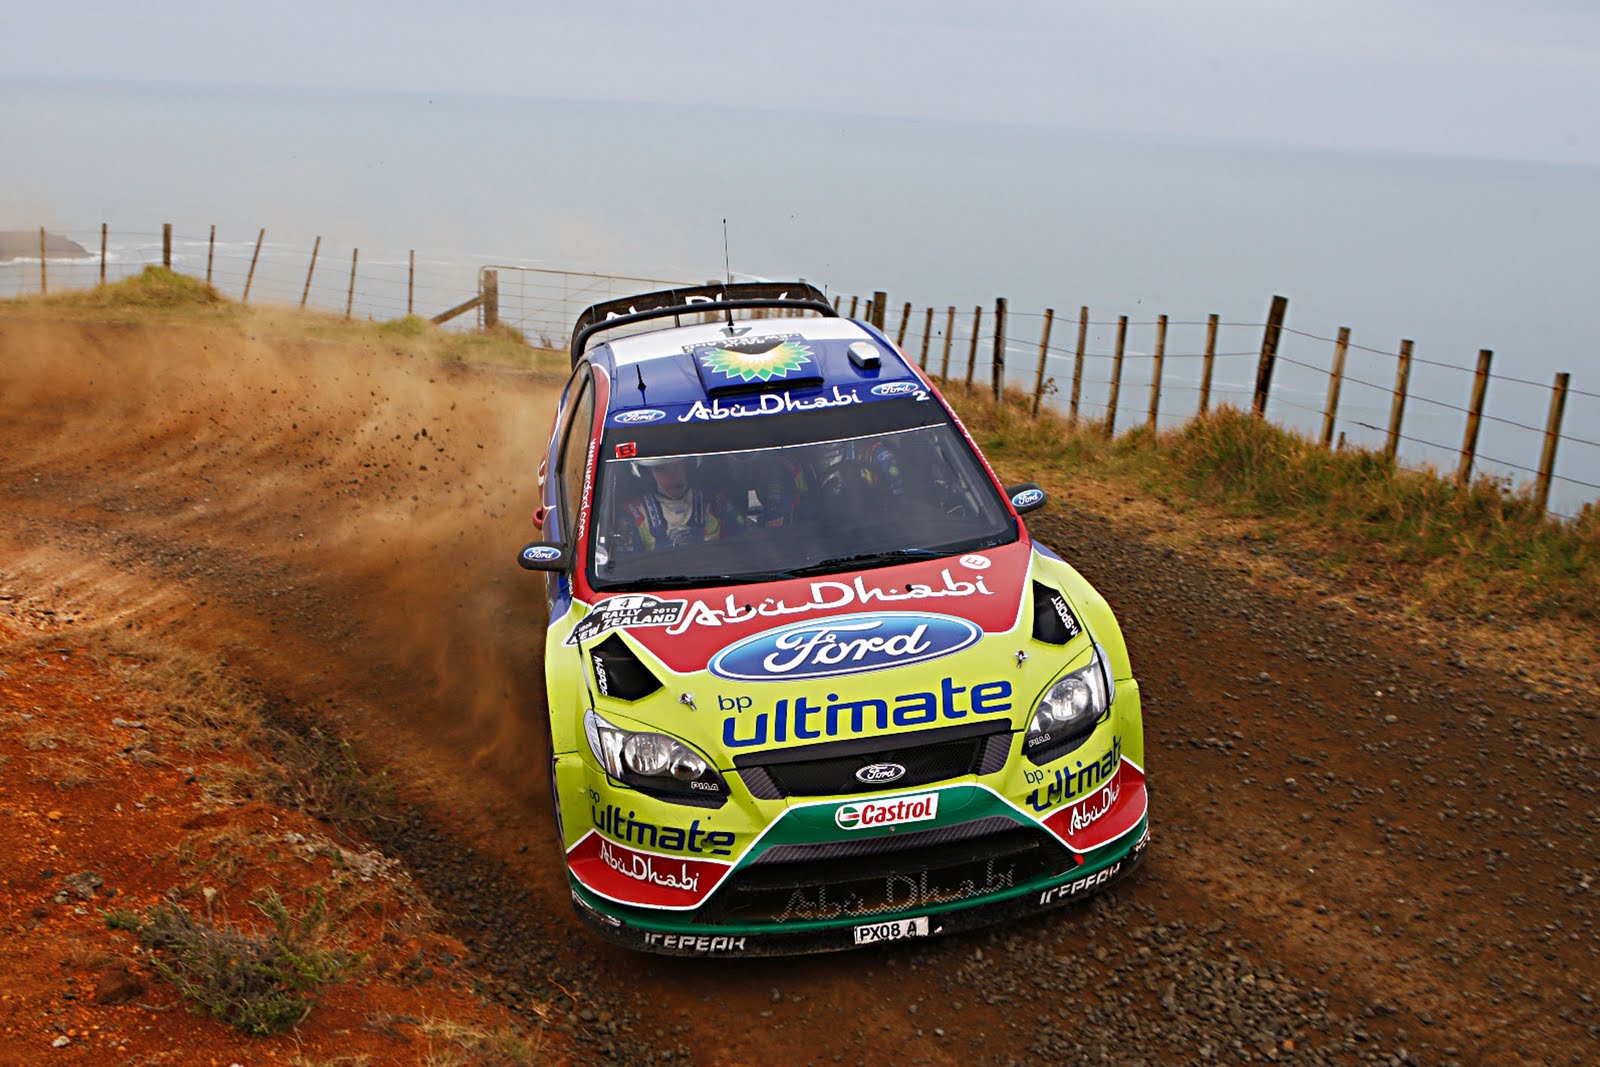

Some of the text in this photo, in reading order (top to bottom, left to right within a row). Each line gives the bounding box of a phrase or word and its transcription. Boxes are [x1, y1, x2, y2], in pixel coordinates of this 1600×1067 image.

[881, 384, 911, 394] Ford
[912, 390, 930, 401] 2
[624, 411, 656, 421] Ford
[1018, 492, 1039, 504] Ford
[528, 549, 554, 559] Ford
[620, 599, 631, 608] 4
[601, 609, 643, 621] RALLY
[602, 613, 677, 631] ZEALAND
[763, 620, 932, 673] Ford
[717, 694, 753, 714] bp
[722, 677, 1013, 748] ultimate
[866, 766, 897, 780] Ford
[1023, 769, 1044, 785] bp
[1029, 735, 1122, 812] ultimat
[861, 798, 932, 825] Castrol
[592, 804, 736, 856] ultimate
[860, 923, 900, 940] PX08
